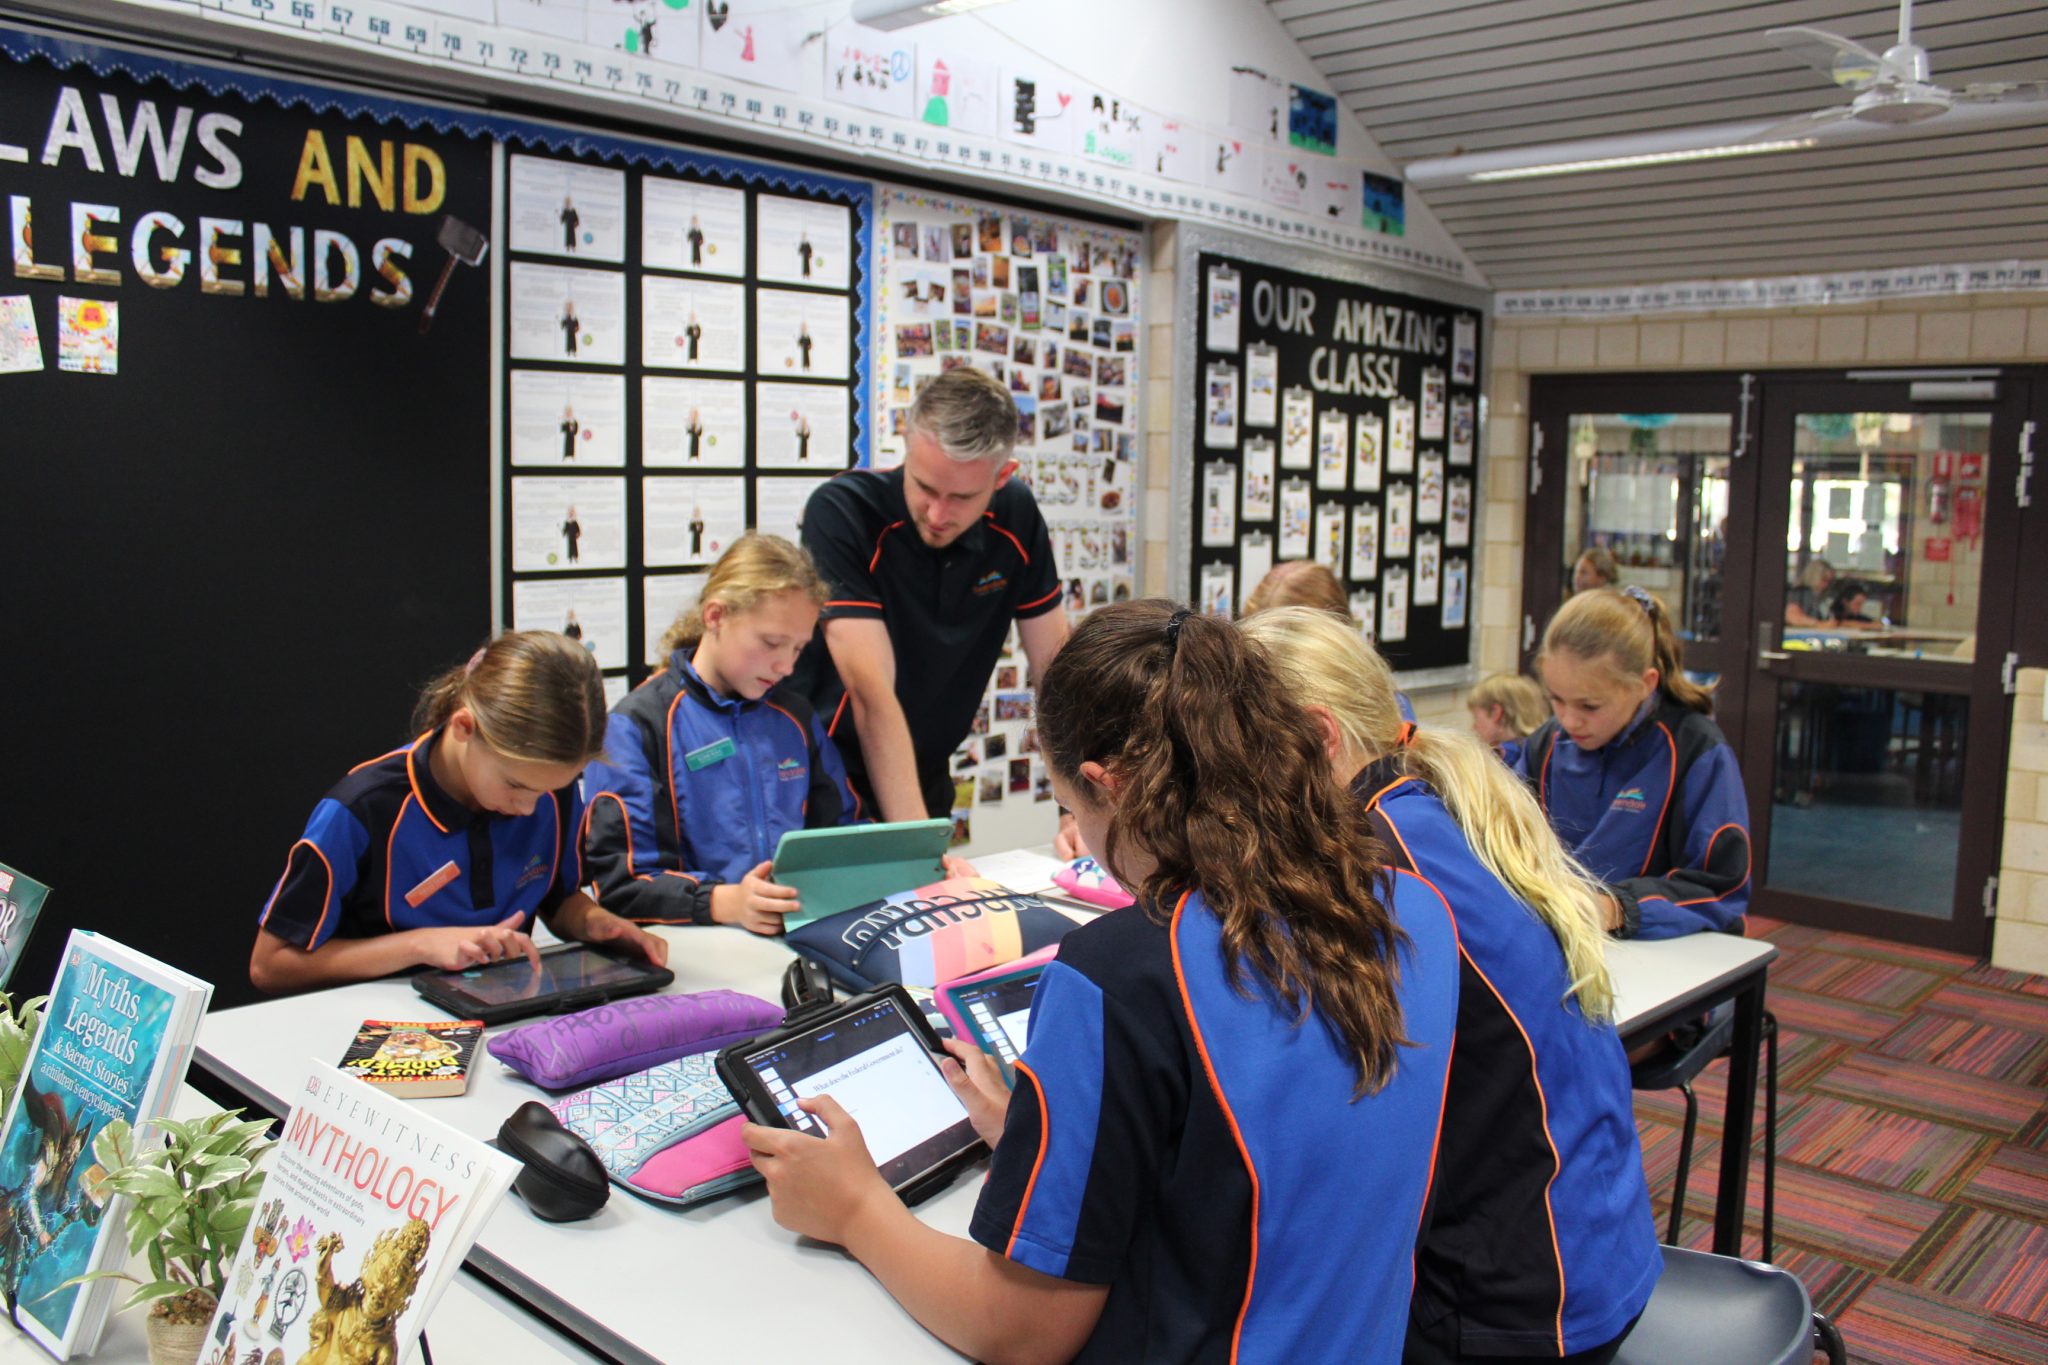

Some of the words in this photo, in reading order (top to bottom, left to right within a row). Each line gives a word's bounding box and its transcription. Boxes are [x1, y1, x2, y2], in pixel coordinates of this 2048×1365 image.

[291, 1, 314, 19] 66
[331, 7, 353, 25] 67
[368, 16, 390, 35] 68
[405, 26, 427, 44] 69
[442, 34, 461, 50] 70
[478, 41, 494, 58] 71
[509, 47, 528, 65] 72
[543, 53, 561, 69] 73
[573, 60, 592, 76] 74
[605, 66, 623, 82] 75
[636, 72, 653, 88] 76
[664, 79, 680, 95] 77
[692, 86, 708, 102] 78
[720, 92, 736, 108] 79
[746, 99, 762, 114] 80
[774, 105, 787, 120] 81
[798, 110, 814, 126] 82
[291, 129, 447, 215] AND
[10, 195, 414, 309] LEGENDS
[1252, 280, 1317, 337] OUR
[1332, 299, 1447, 357] AMAZING
[1308, 346, 1400, 398] CLASS!
[83, 962, 141, 1025] Myths,
[64, 997, 138, 1064] Legends
[346, 1056, 459, 1069] DOOMED!
[47, 1064, 80, 1094] children's
[78, 1086, 125, 1120] encyclopedia
[54, 1036, 64, 1054] &
[63, 1041, 95, 1073] Sacred
[94, 1060, 129, 1094] Stories
[371, 1068, 434, 1076] JUST
[323, 1086, 476, 1179] EYEWITNESS
[287, 1107, 460, 1231] MYTHOLOGY
